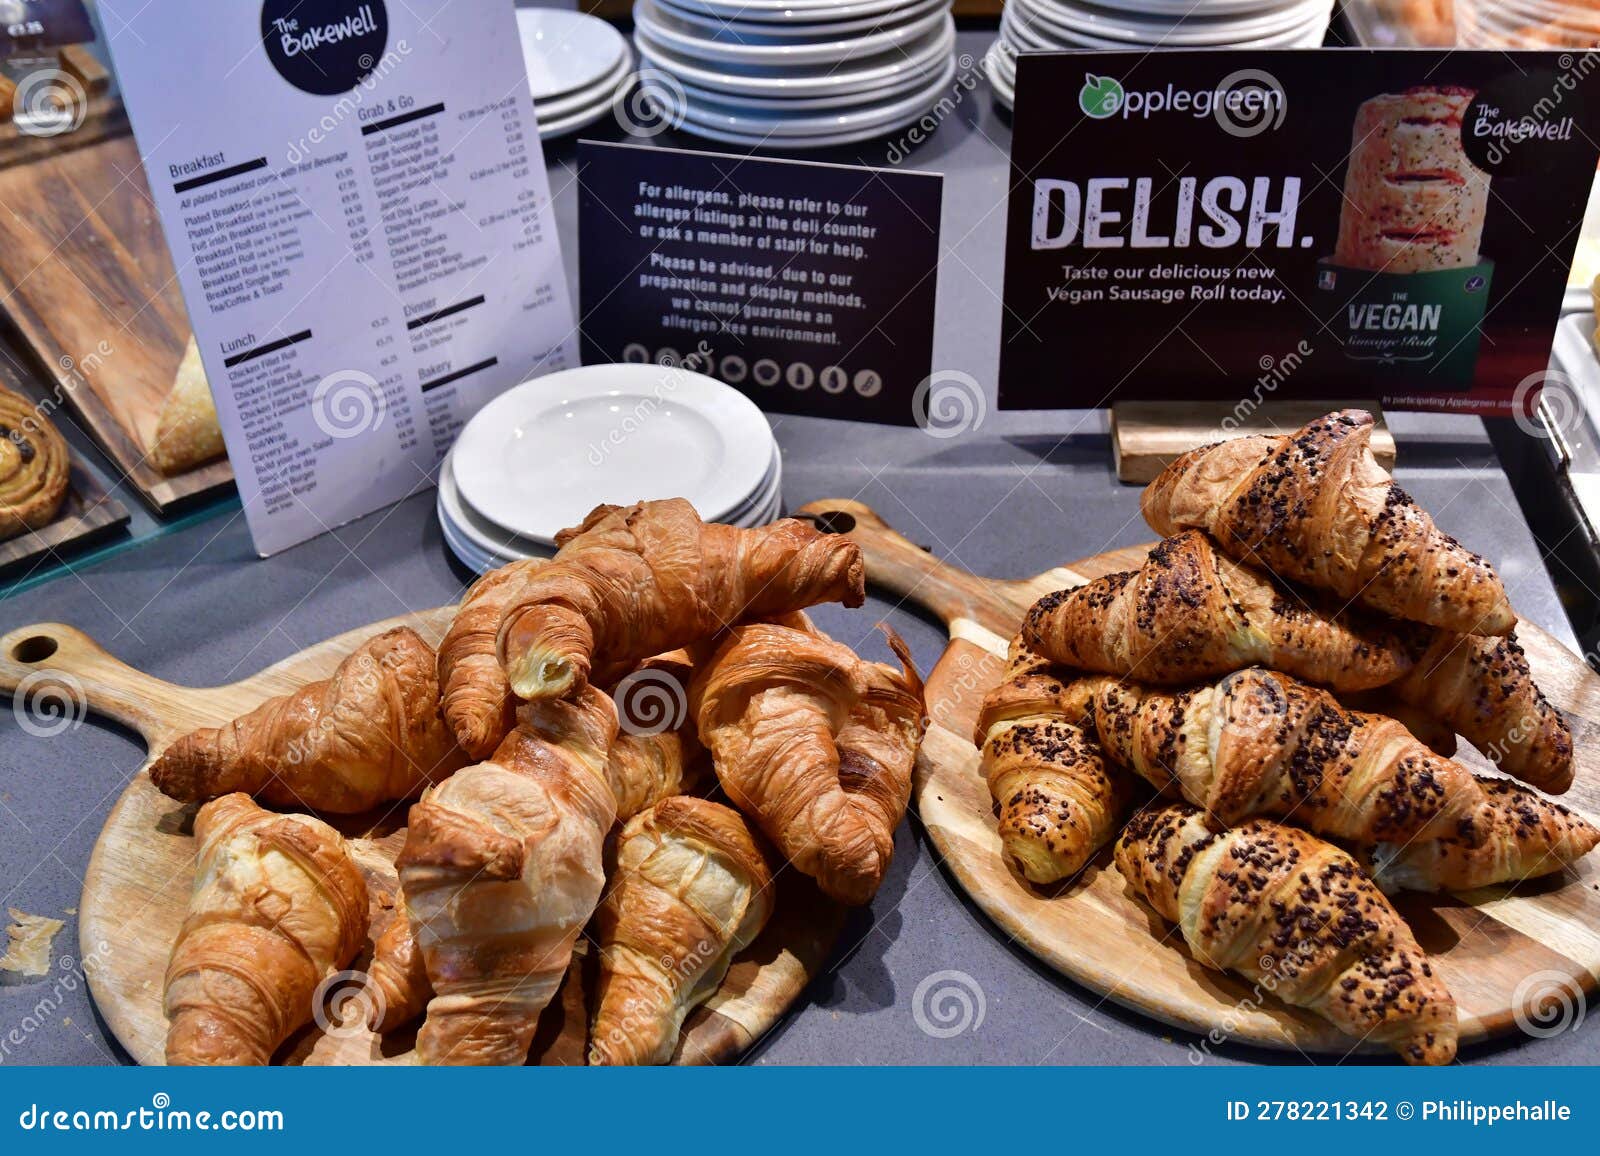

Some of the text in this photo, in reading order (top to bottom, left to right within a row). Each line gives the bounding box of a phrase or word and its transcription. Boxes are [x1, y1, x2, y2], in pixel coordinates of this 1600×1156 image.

[272, 18, 299, 33] The
[280, 5, 377, 57] Bakewell
[358, 95, 414, 121] Grab & Go
[1102, 83, 1282, 119] applegreen
[1476, 104, 1499, 118] The
[1474, 117, 1573, 140] Bakewell
[169, 152, 225, 178] Breakfast
[180, 199, 191, 210] All
[193, 191, 217, 207] plated
[219, 180, 255, 198] breakfast
[639, 182, 660, 198] For
[739, 193, 783, 210] please
[789, 198, 822, 213] refer
[826, 200, 840, 215] to
[845, 204, 868, 217] our
[184, 212, 211, 227] Plated
[634, 204, 876, 238] allergen listings at the deli counter
[1031, 176, 1314, 249] DELISH.
[229, 222, 266, 240] Breakfast
[195, 240, 252, 265] Breakfast Roll
[640, 226, 868, 260] or ask a member of staff for help.
[199, 251, 255, 277] Breakfast Roll
[651, 252, 695, 271] Please
[700, 258, 716, 273] be
[782, 266, 806, 282] due
[811, 269, 825, 284] to
[829, 272, 852, 286] our
[1062, 264, 1275, 279] Taste our delicious new
[202, 264, 258, 290] Breakfast Roll
[261, 282, 283, 295] Toast
[640, 274, 717, 293] preparation
[720, 280, 745, 296] and
[750, 283, 798, 302] display
[206, 282, 243, 302] Breakfast
[1047, 285, 1286, 303] Vegan Sausage Roll today.
[1392, 292, 1408, 301] THE
[403, 298, 436, 317] Dinner
[671, 297, 832, 325] we cannot guarantee an
[1348, 303, 1442, 330] VEGAN
[662, 315, 717, 333] allergen
[752, 324, 841, 345] environment.
[220, 333, 256, 353] Lunch
[228, 364, 260, 380] Chicken
[418, 361, 451, 379] Bakery
[234, 384, 265, 401] Chicken
[1393, 396, 1446, 407] participating
[1447, 398, 1495, 408] Applegreen
[245, 421, 283, 440] Sandwich
[252, 447, 282, 463] Carvery
